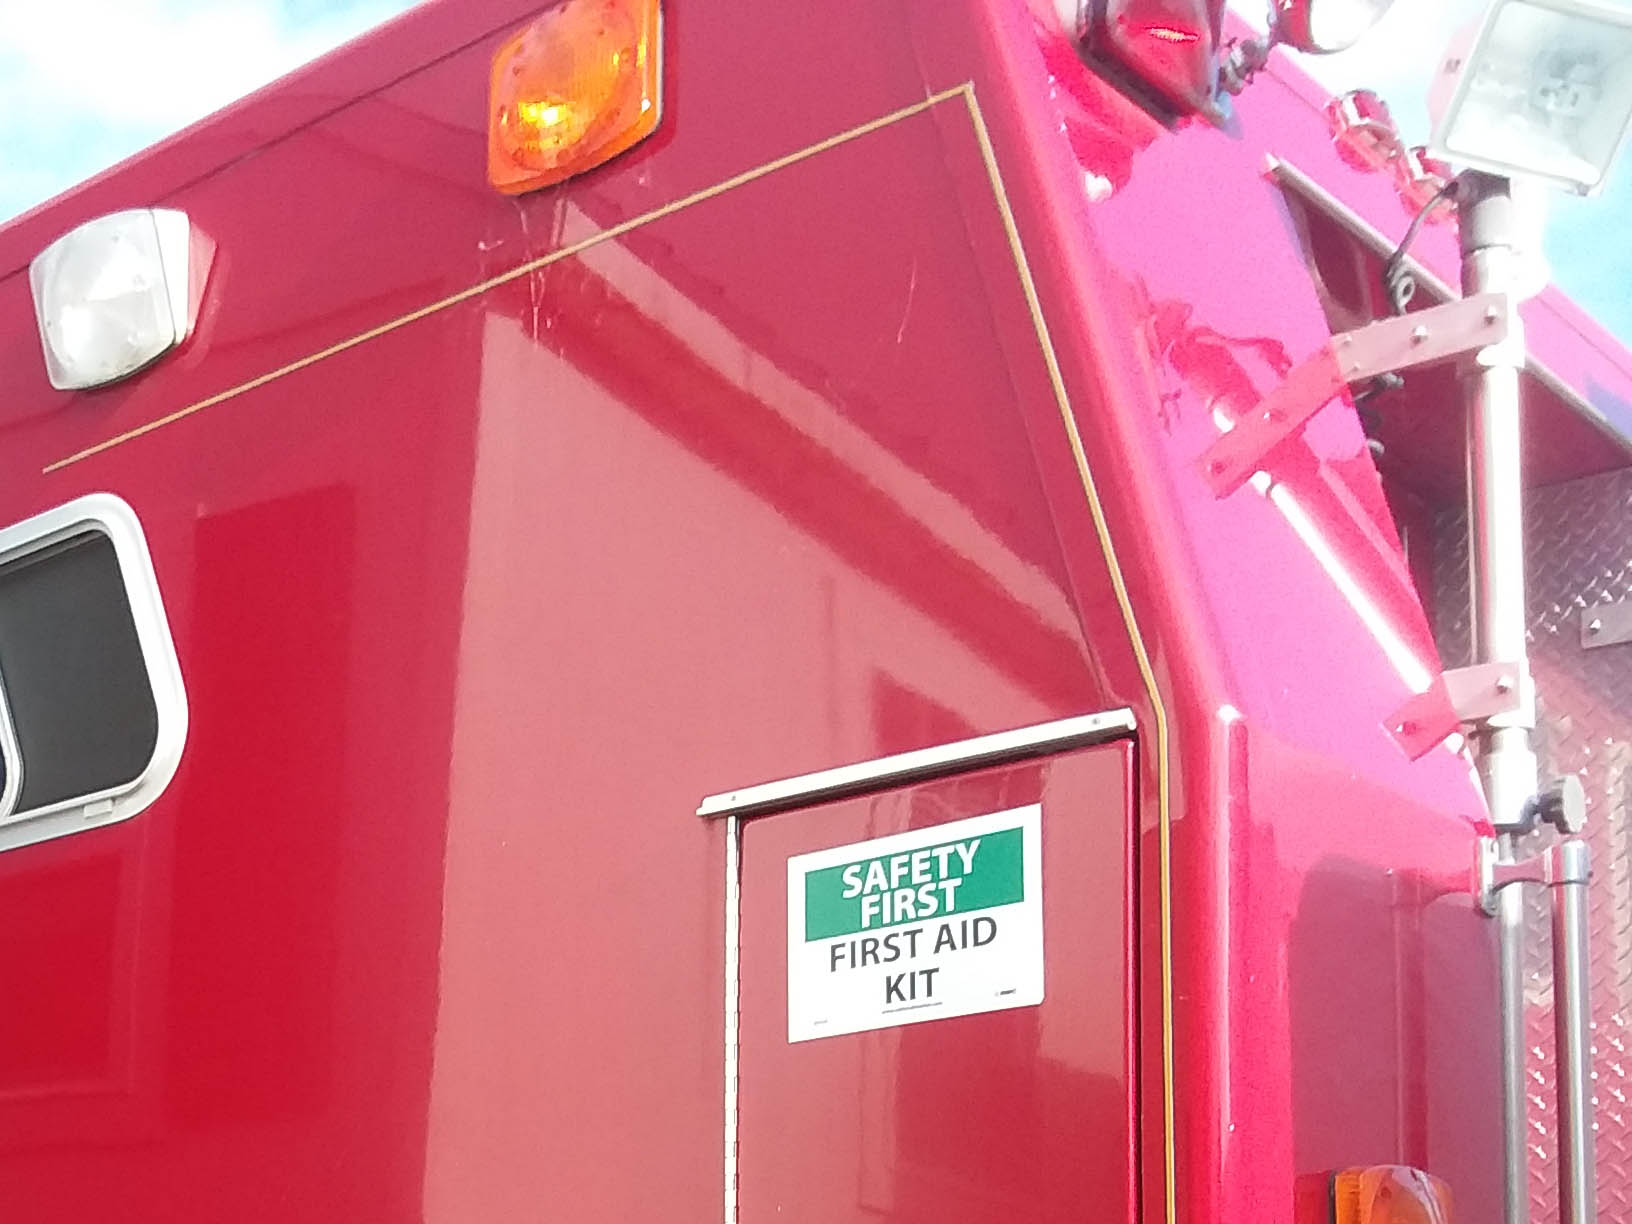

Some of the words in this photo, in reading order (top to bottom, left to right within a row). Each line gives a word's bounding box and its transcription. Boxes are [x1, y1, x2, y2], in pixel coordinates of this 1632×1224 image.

[842, 839, 981, 899] SAFETY
[861, 877, 962, 929] FIRST
[830, 928, 924, 972] FIRST
[933, 916, 998, 954] AID
[885, 967, 939, 1004] KIT
